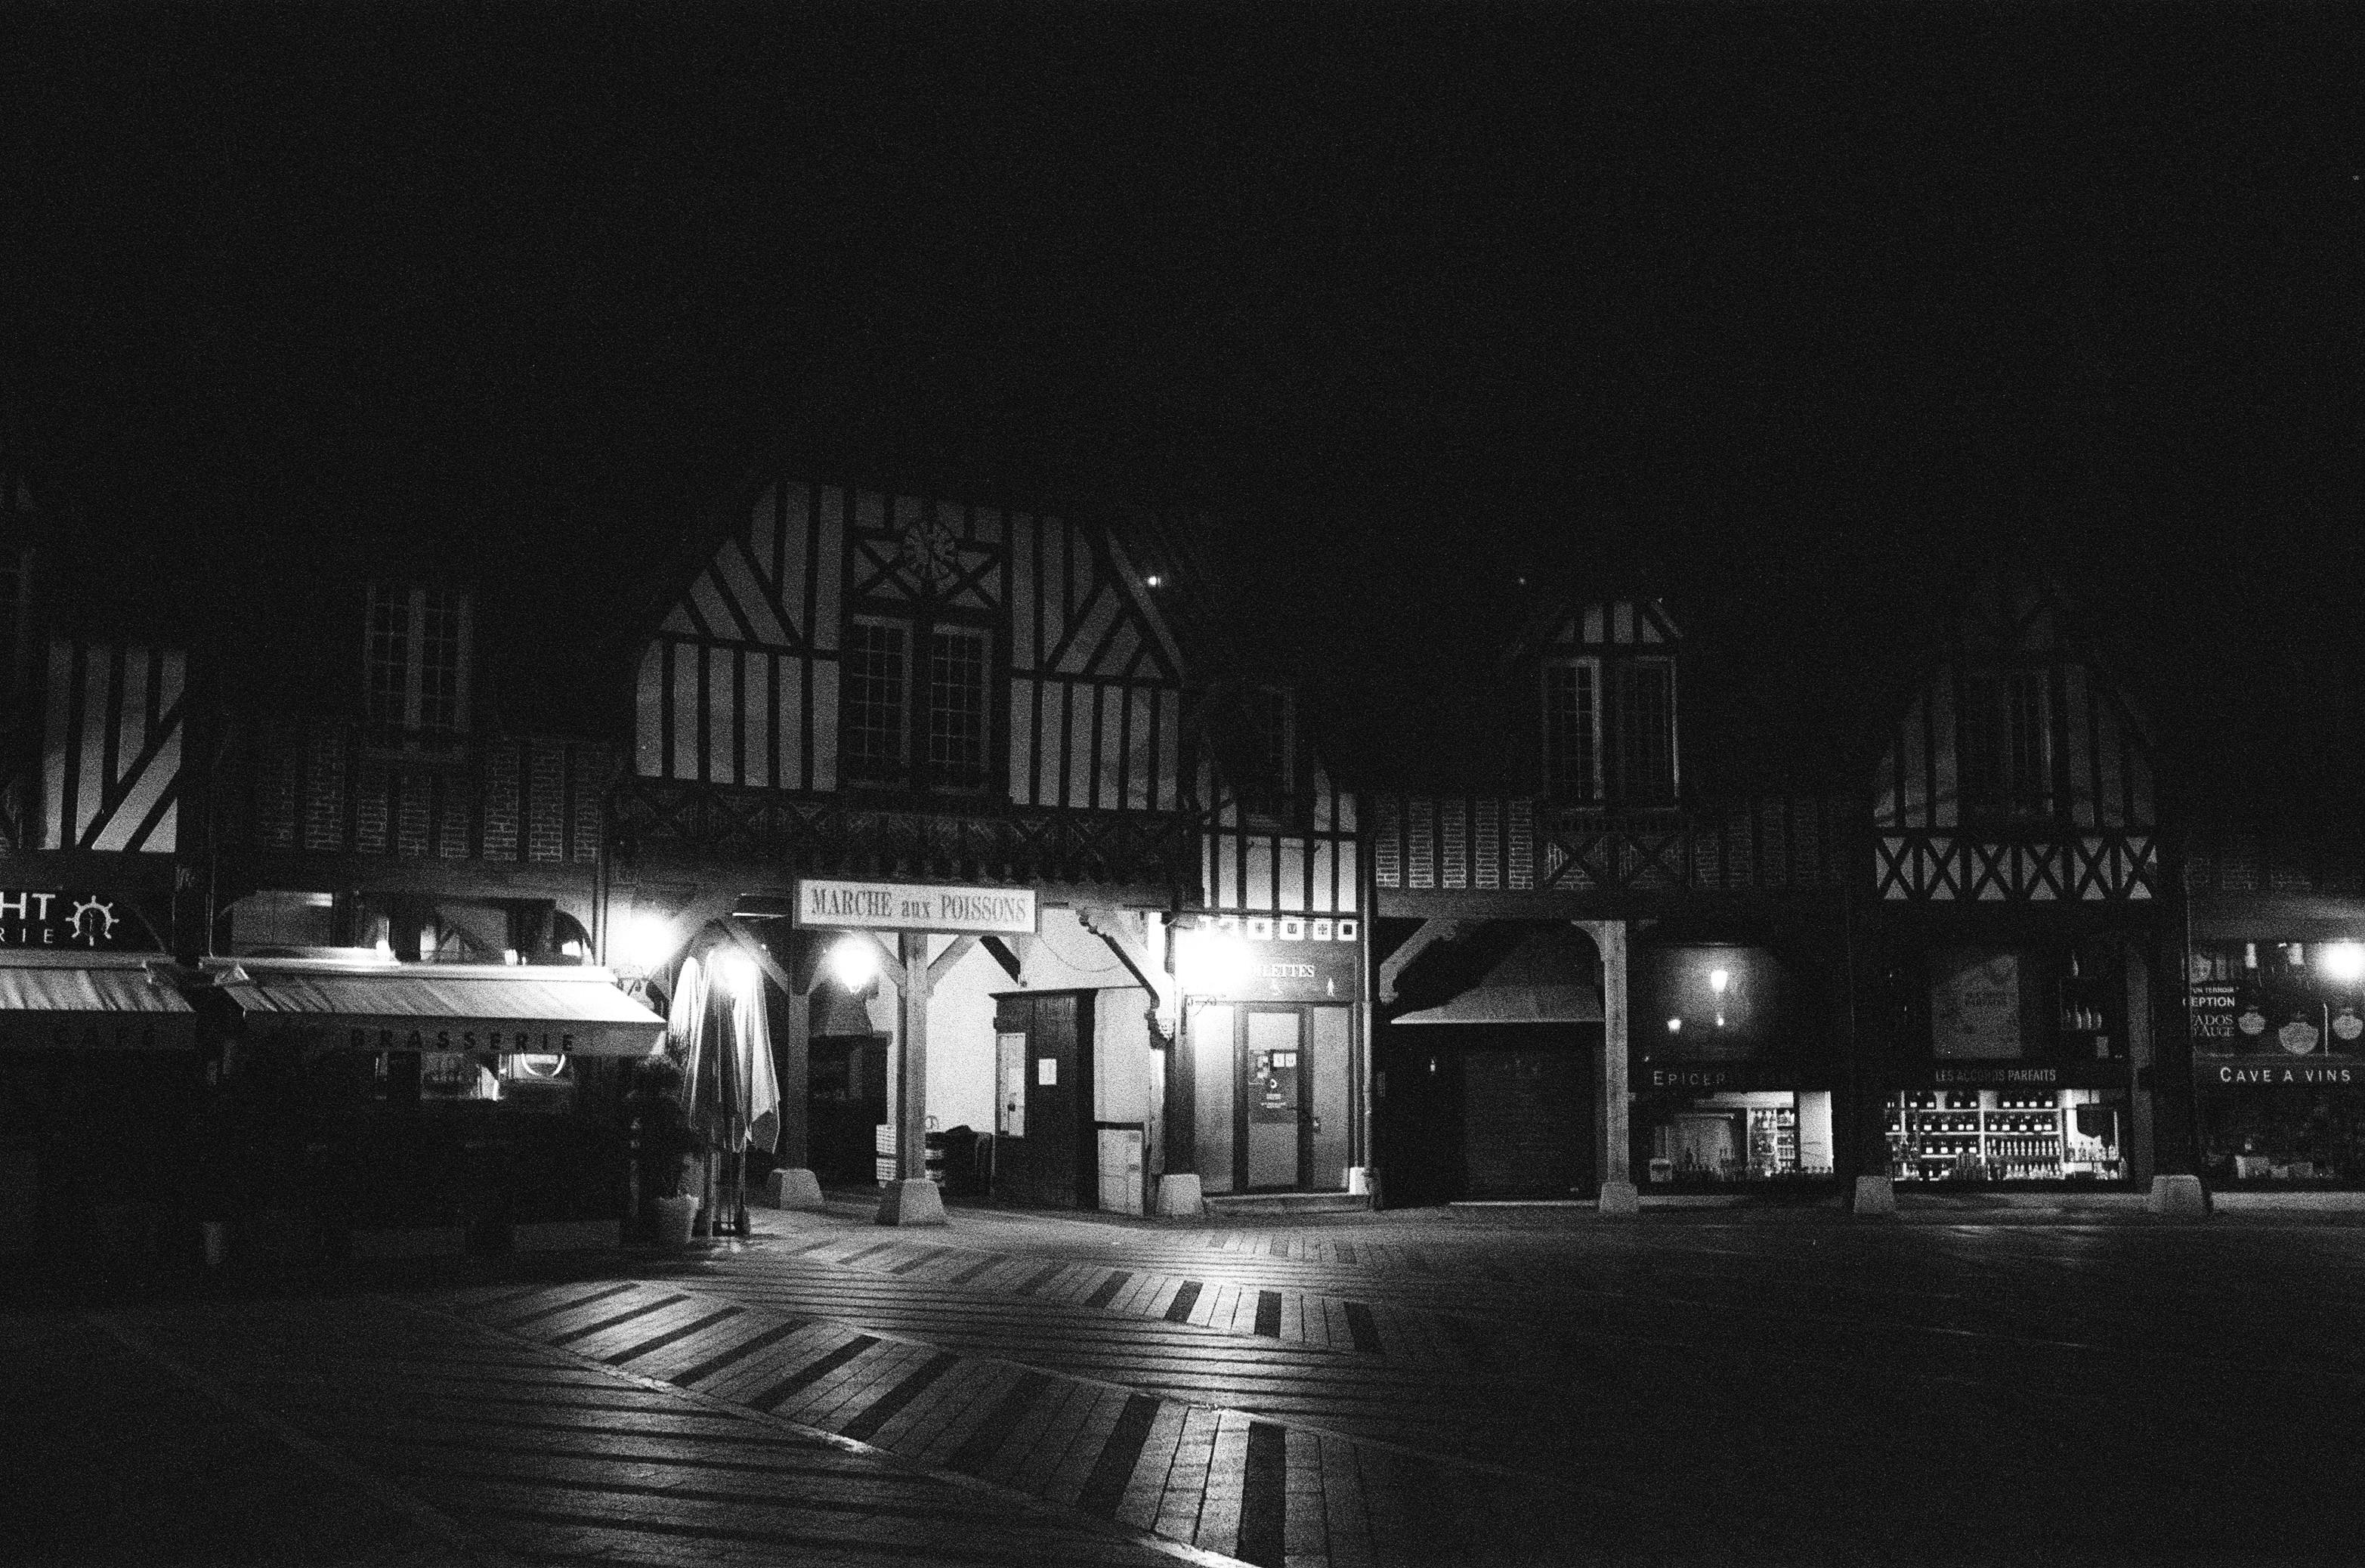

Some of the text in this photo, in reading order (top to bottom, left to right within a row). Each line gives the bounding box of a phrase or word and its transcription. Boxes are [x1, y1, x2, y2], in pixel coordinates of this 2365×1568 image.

[0, 892, 56, 920] HT
[901, 901, 931, 918] aux
[941, 895, 1026, 921] POISSONS
[2192, 1014, 2234, 1025] ADOS
[351, 1028, 573, 1051] BRASSERIE
[1935, 1069, 1954, 1082] LES
[2008, 1069, 2056, 1082] PARFAITS
[2283, 1069, 2293, 1082] A
[2305, 1069, 2351, 1082] VINS
